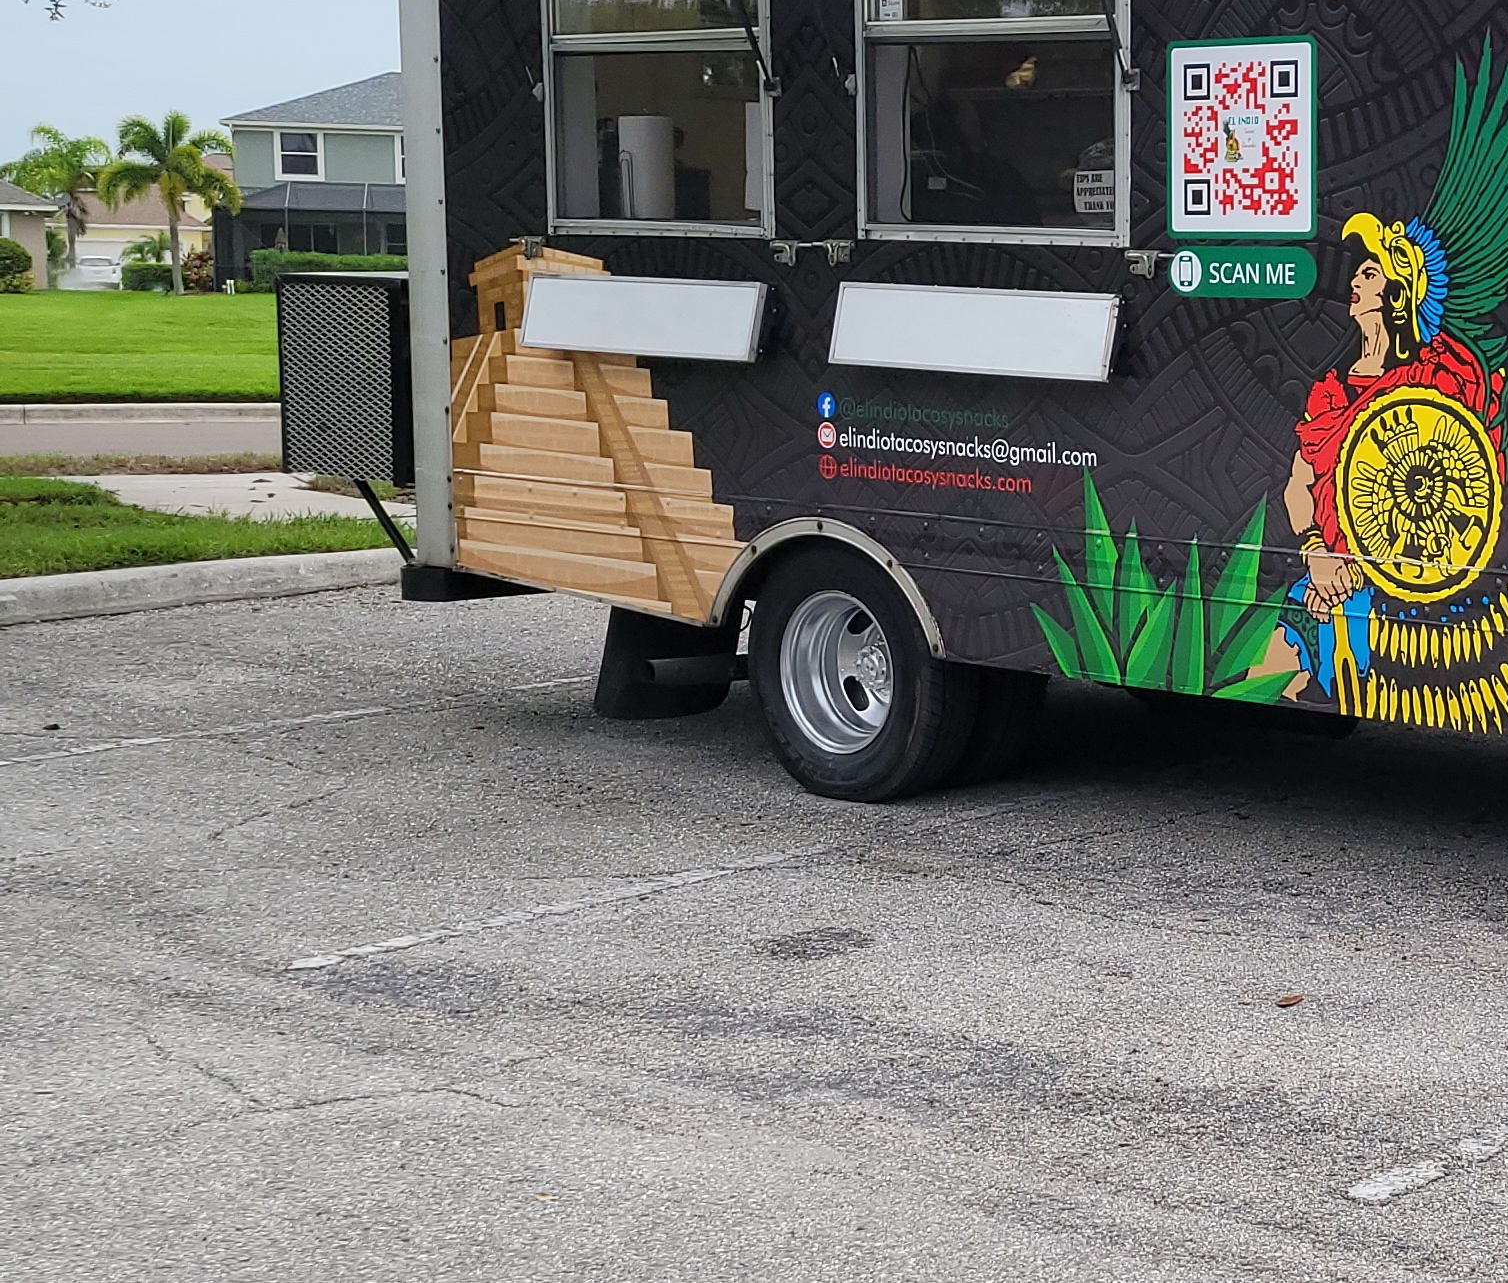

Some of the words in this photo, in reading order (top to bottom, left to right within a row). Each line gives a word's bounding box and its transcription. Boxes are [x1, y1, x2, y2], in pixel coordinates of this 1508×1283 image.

[1208, 262, 1260, 285] SCAN
[1266, 263, 1296, 285] ME
[839, 425, 1098, 468] elindiotacosysnacks@gmail.com
[840, 457, 1033, 494] elindiotacosysnacks.com
